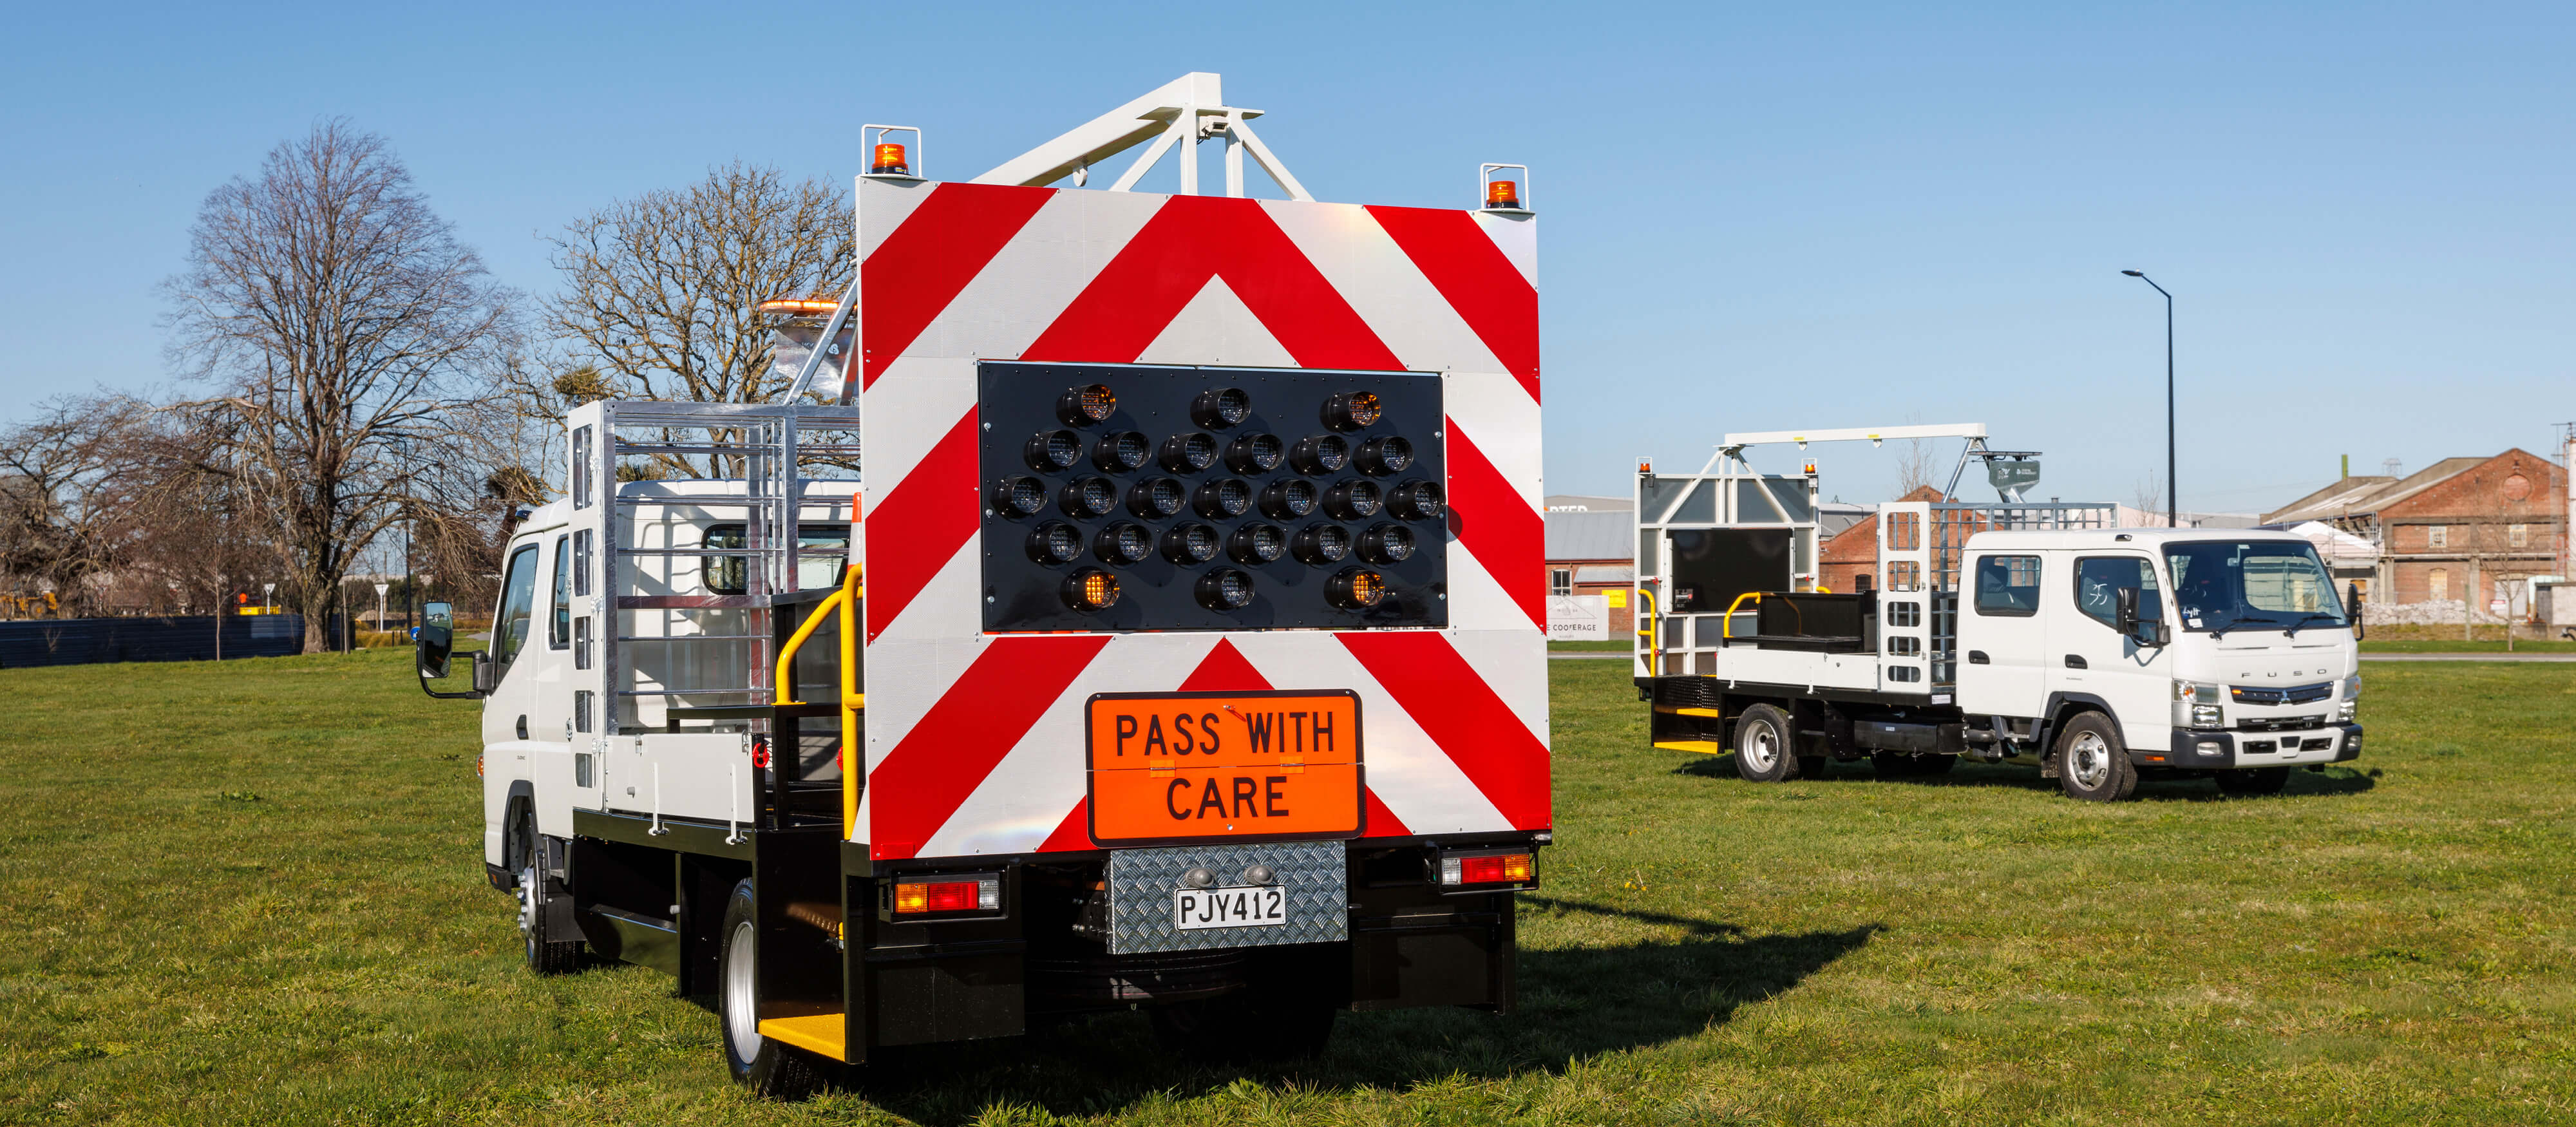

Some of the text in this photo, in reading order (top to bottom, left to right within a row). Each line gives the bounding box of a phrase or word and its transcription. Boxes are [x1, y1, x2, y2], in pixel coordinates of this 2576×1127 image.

[2241, 668, 2327, 678] FUSO
[1116, 711, 1334, 757] PASS WITH
[1167, 776, 1289, 820] CARE
[1181, 891, 1282, 923] PJY412
